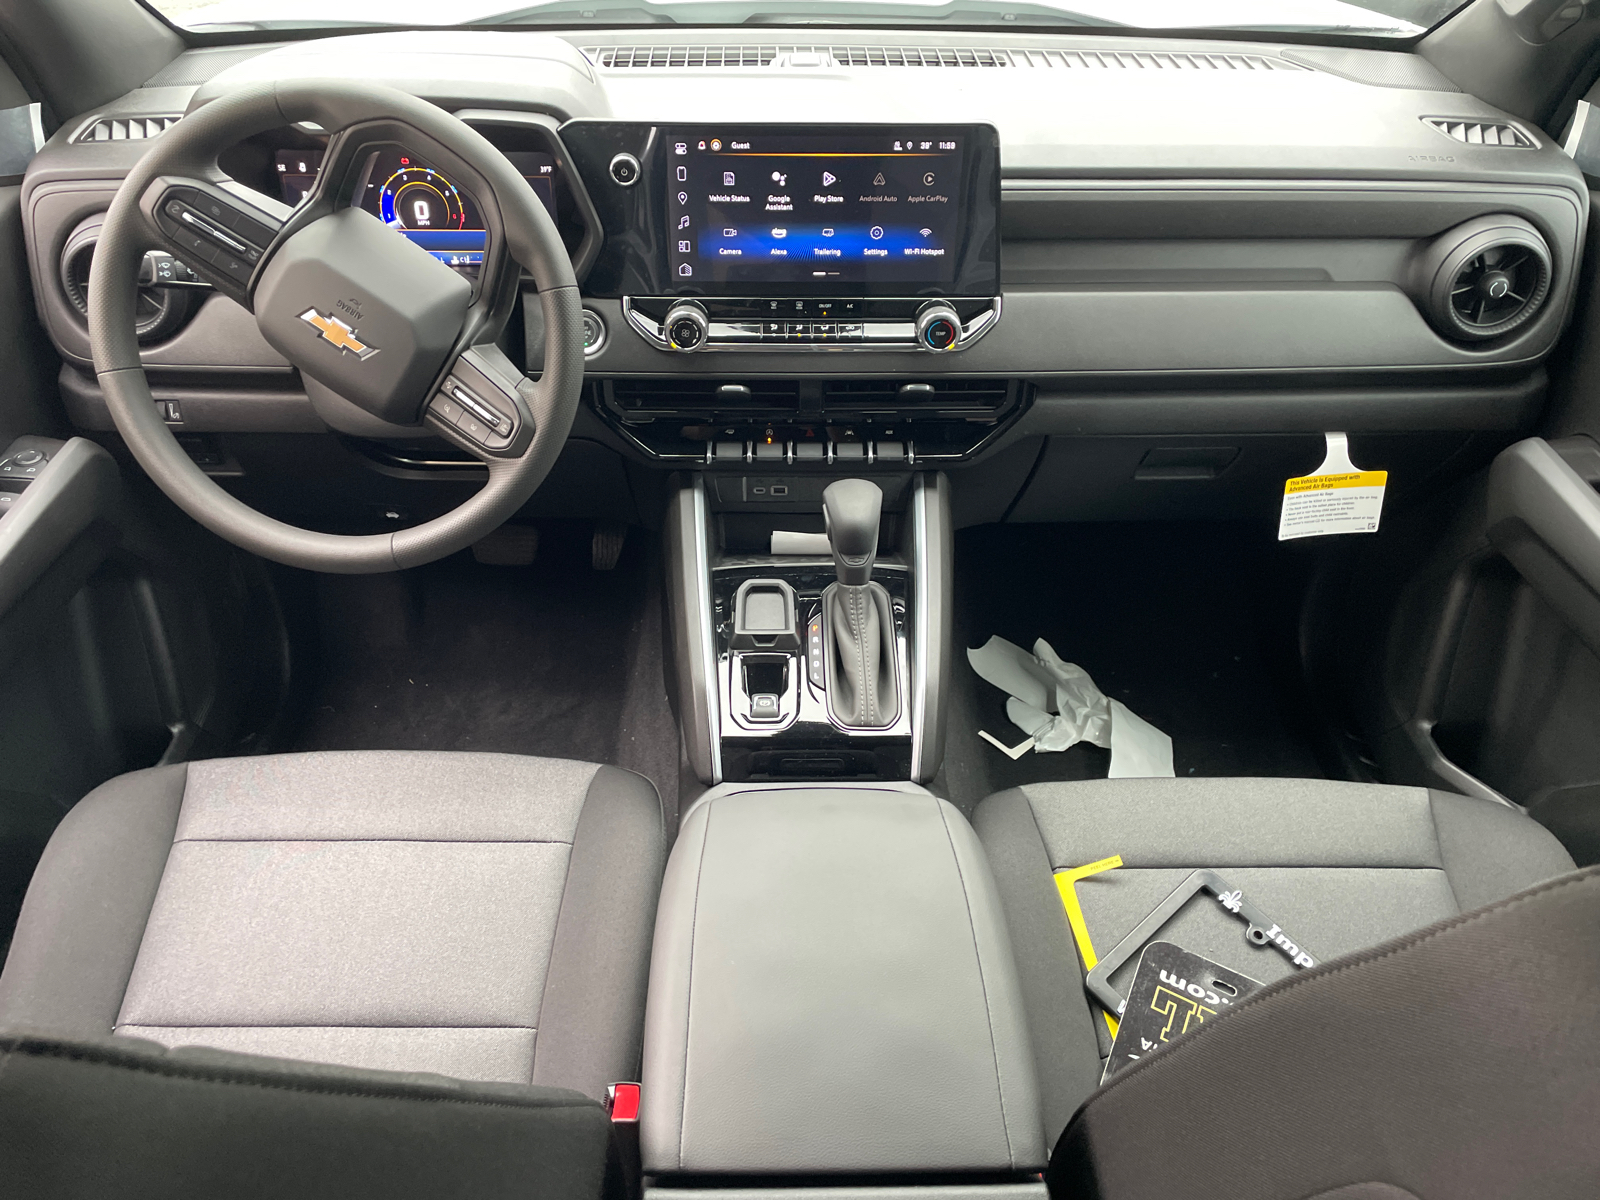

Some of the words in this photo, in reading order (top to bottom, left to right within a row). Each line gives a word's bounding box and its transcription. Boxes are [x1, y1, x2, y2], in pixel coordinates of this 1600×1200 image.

[731, 141, 750, 150] Guest
[939, 141, 956, 149] 11:59
[1408, 155, 1455, 163] AIRBAG
[708, 194, 731, 203] Vehicle
[731, 194, 750, 203] Status
[767, 195, 791, 204] Google
[814, 194, 827, 204] Play
[827, 194, 844, 203] Store
[859, 194, 883, 202] Android
[907, 195, 925, 204] Apple
[925, 195, 949, 204] CarPlay
[413, 200, 430, 220] 0
[764, 203, 794, 211] Assistant
[719, 247, 743, 255] Camera
[814, 248, 842, 256] Trailering
[863, 248, 889, 256] Settings
[920, 248, 945, 256] Hotspot
[336, 299, 364, 321] AIRBAG
[1324, 475, 1348, 483] Equipped
[1289, 484, 1312, 492] Advanced
